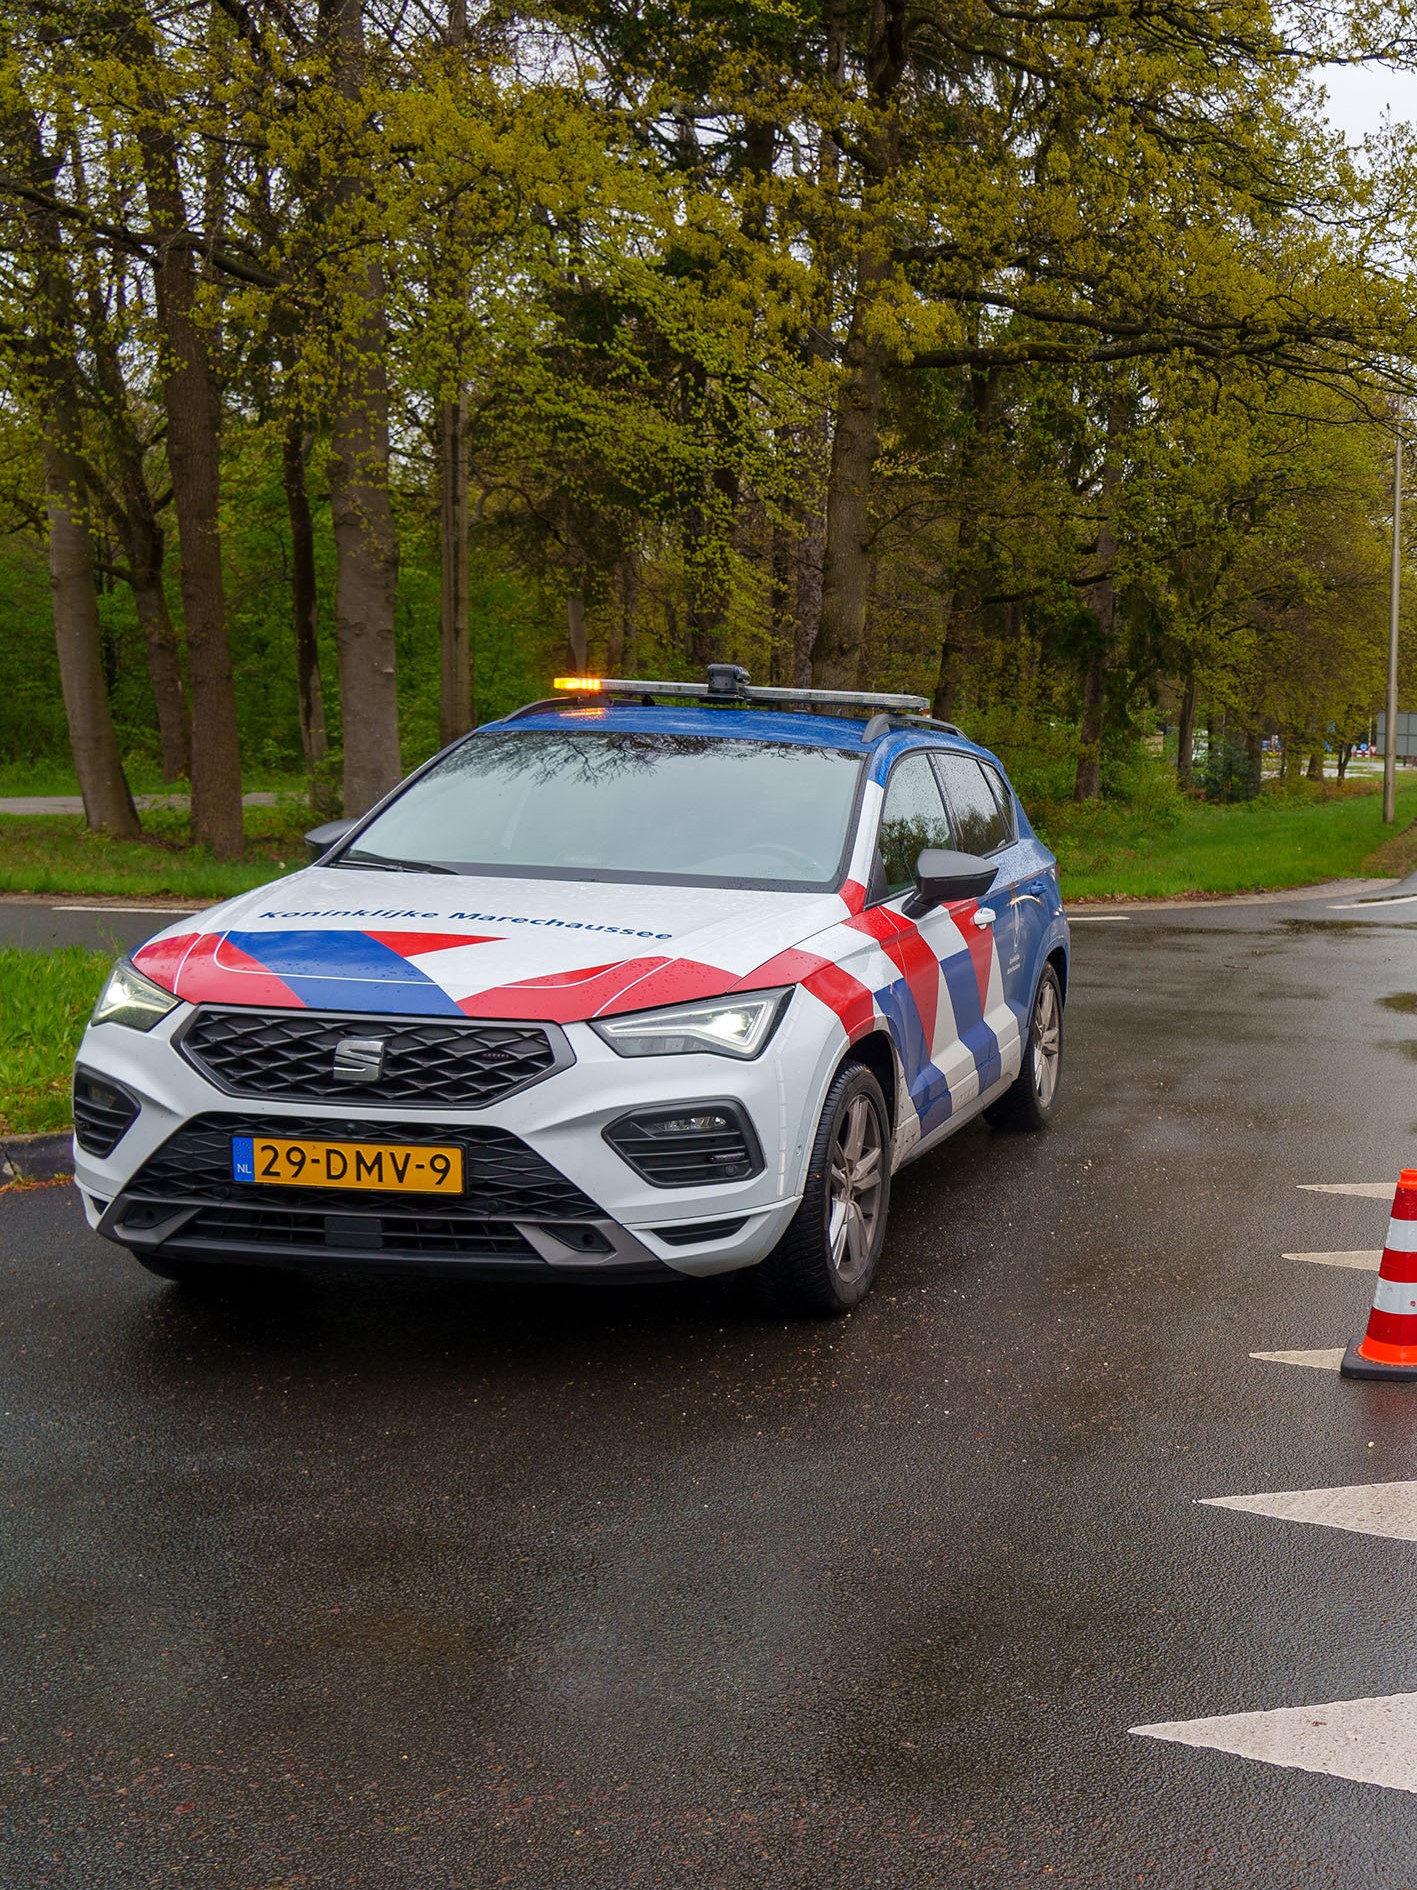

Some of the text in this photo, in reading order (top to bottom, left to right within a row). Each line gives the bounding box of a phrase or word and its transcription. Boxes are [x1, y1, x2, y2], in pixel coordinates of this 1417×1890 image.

[257, 908, 673, 940] Koninklijke Marechaussee
[236, 1144, 451, 1185] NL 29-DMV-9
